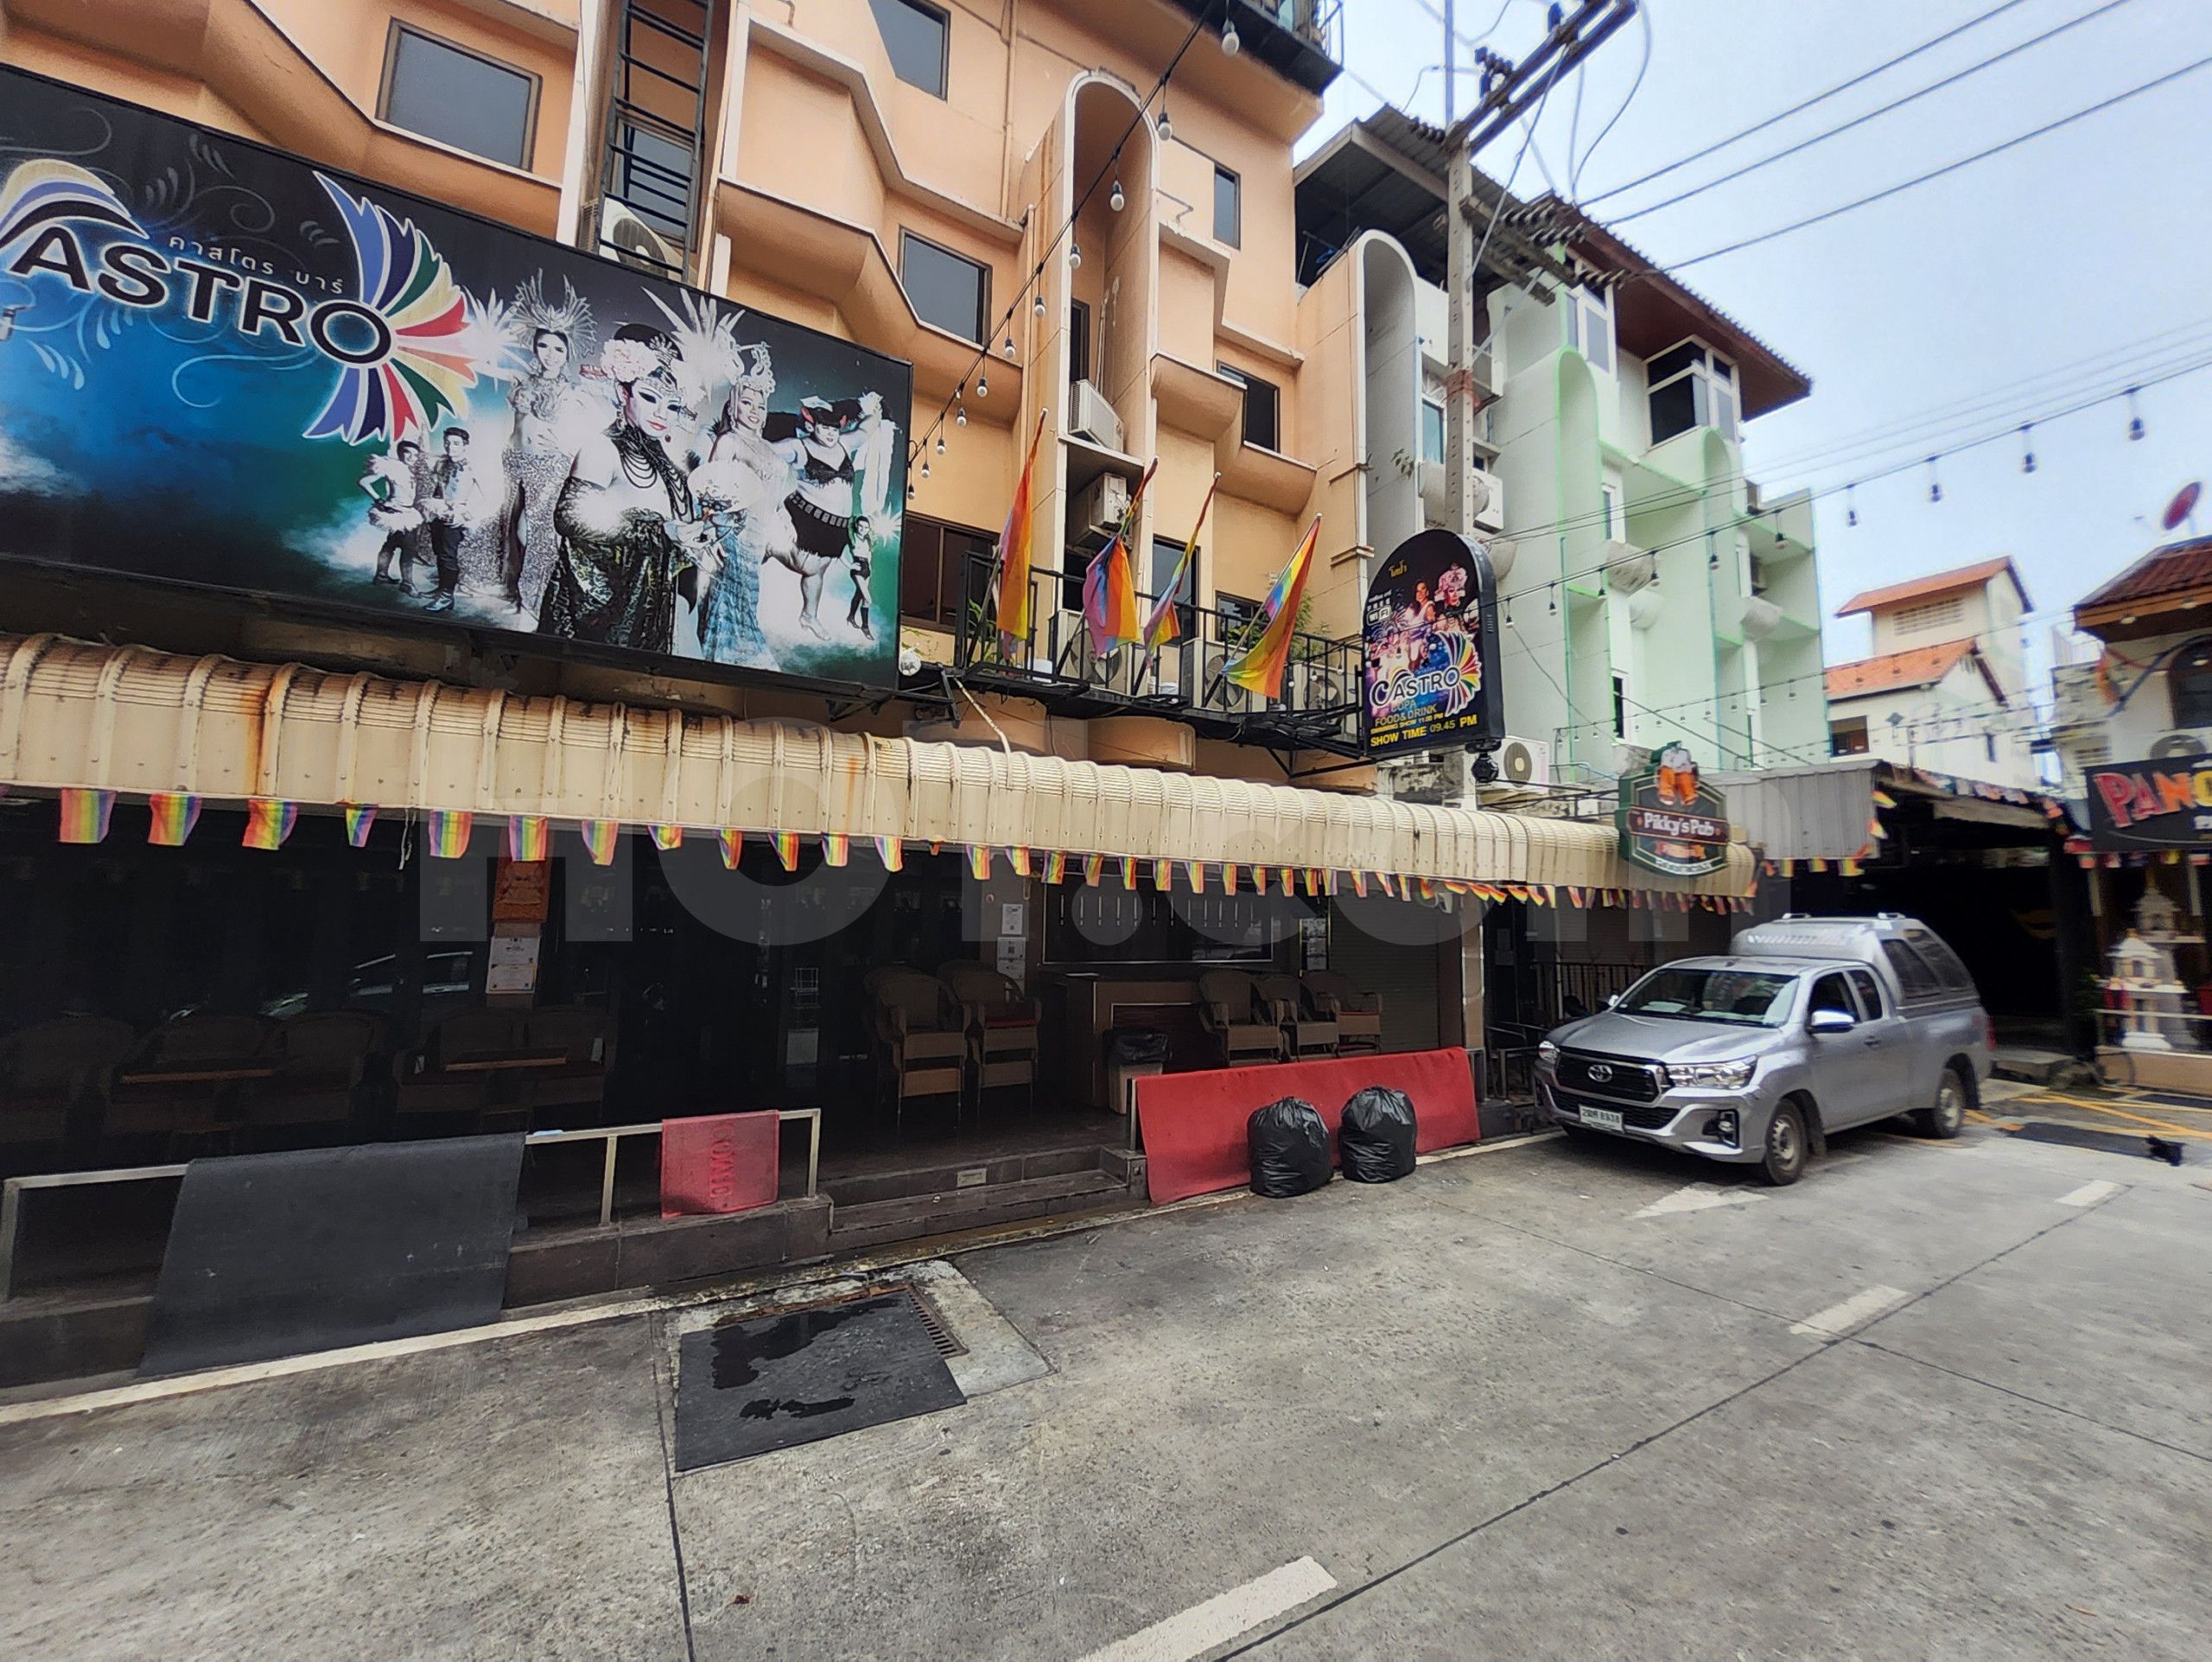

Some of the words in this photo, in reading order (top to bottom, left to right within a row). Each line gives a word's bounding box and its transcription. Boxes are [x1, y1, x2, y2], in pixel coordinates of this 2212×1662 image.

[0, 207, 391, 364] ASTRO
[296, 271, 343, 295] บาร์
[1370, 666, 1457, 707] CASTRO
[1370, 732, 1399, 747] SHOW
[1402, 726, 1427, 740] TIME
[1429, 719, 1455, 733] 09.45
[1459, 714, 1478, 728] PM
